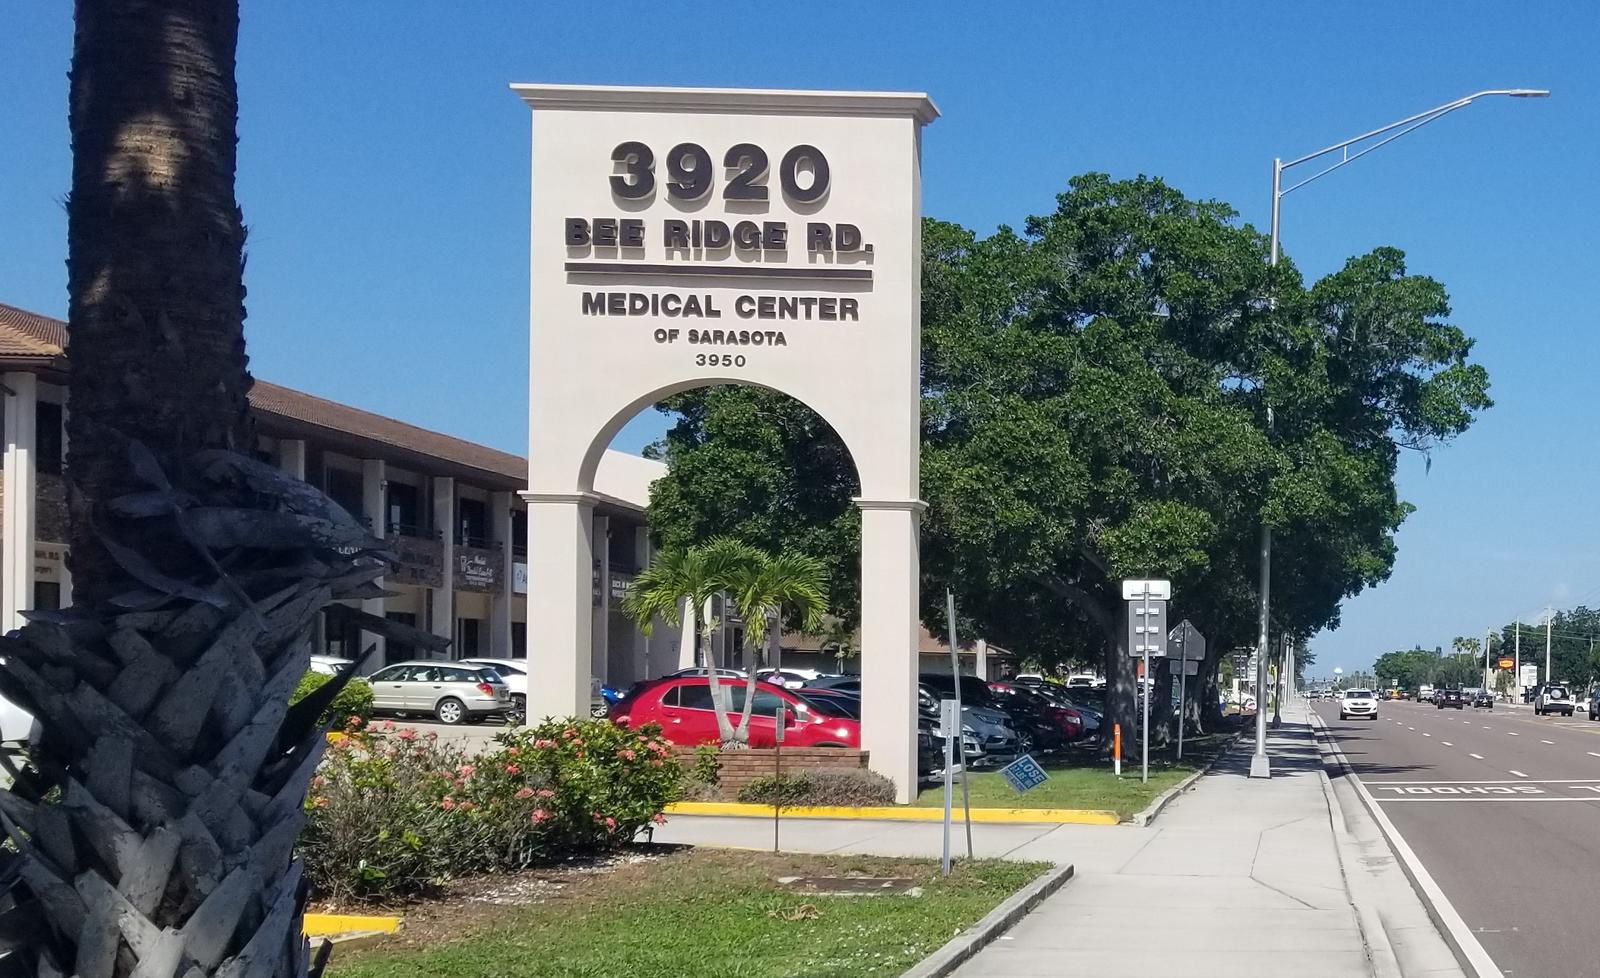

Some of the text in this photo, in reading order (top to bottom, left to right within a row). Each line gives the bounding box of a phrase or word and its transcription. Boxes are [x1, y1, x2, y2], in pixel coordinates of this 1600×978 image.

[608, 141, 831, 202] 3920
[565, 218, 874, 254] BEE RIDGE RD.
[582, 291, 859, 322] MEDICAL CENTER
[653, 328, 788, 348] OF SARASOTA
[695, 353, 747, 368] 3950
[1018, 758, 1046, 784] LOSE
[1378, 786, 1545, 794] SCHOOL
